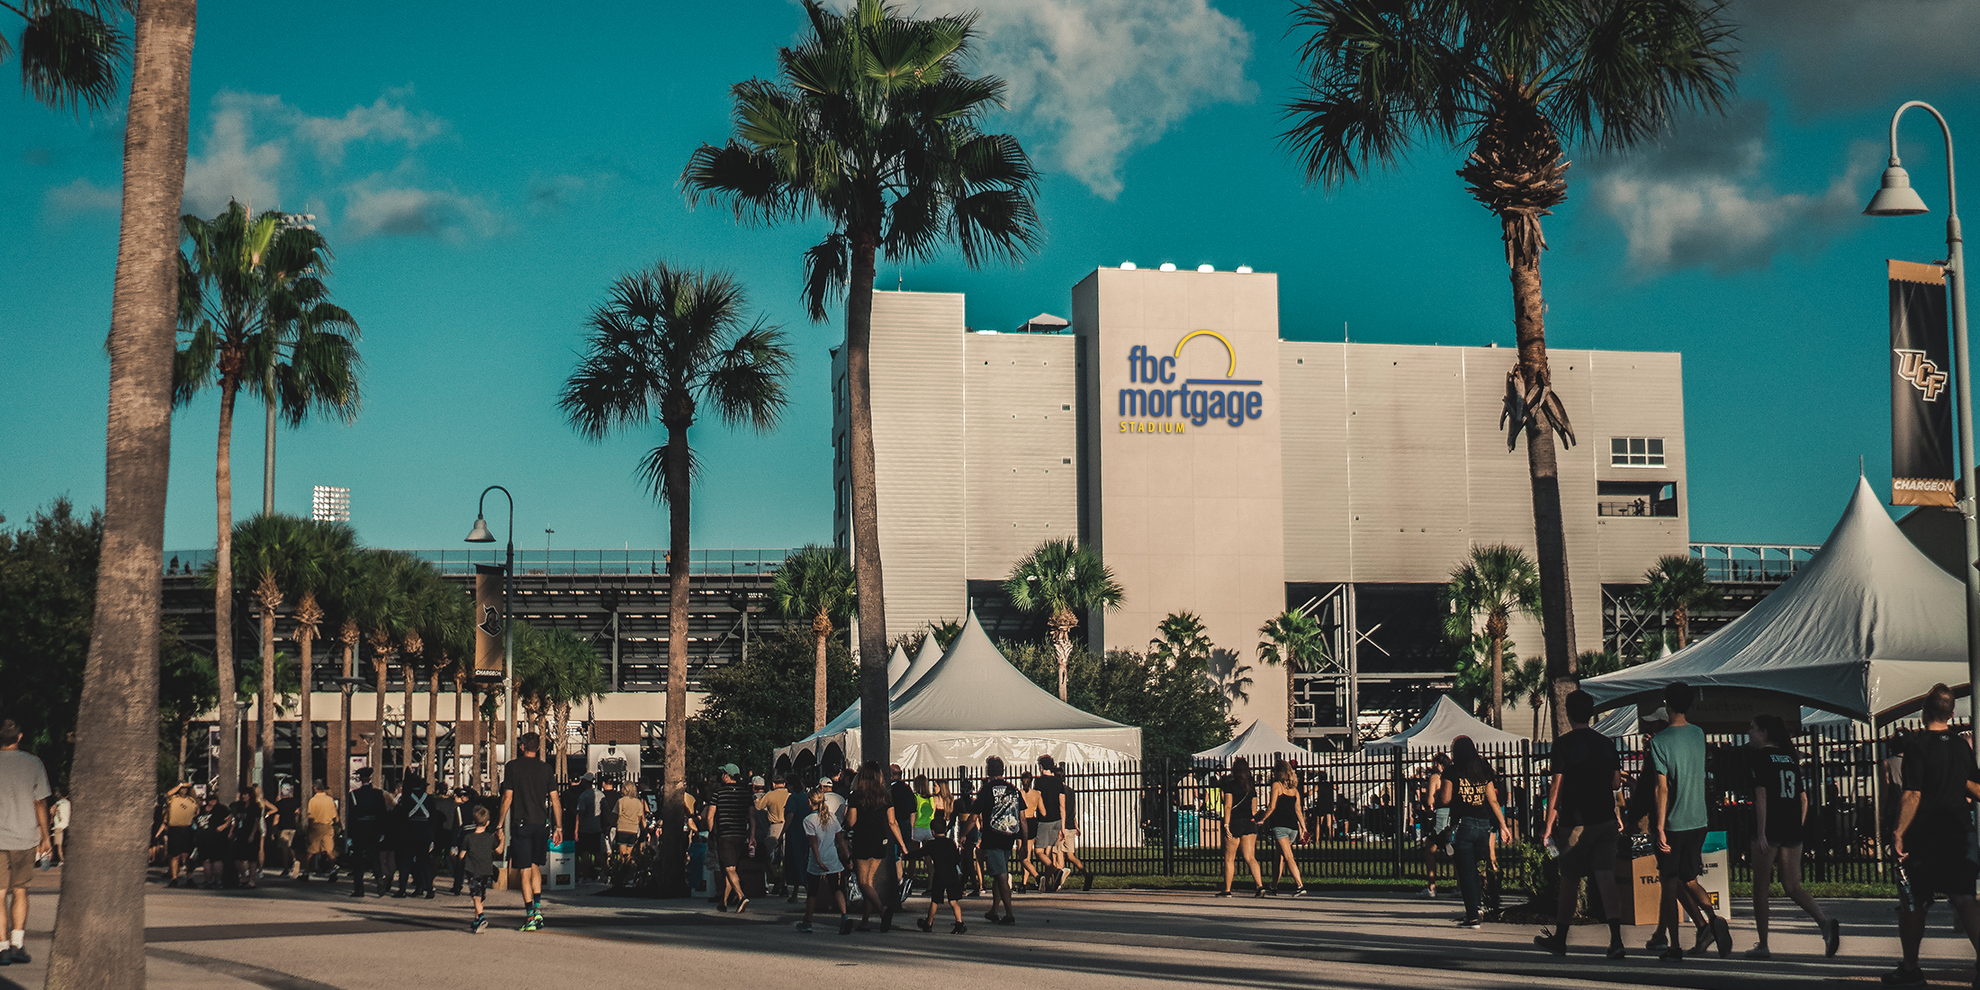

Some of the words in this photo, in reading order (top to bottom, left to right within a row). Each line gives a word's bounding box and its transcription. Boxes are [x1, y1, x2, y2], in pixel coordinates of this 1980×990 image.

[1128, 345, 1176, 383] fbc
[1897, 350, 1946, 400] UCF
[1119, 383, 1263, 427] mortgage
[1119, 421, 1186, 434] STADIUM
[1779, 769, 1796, 799] 13
[1639, 875, 1660, 884] TRA
